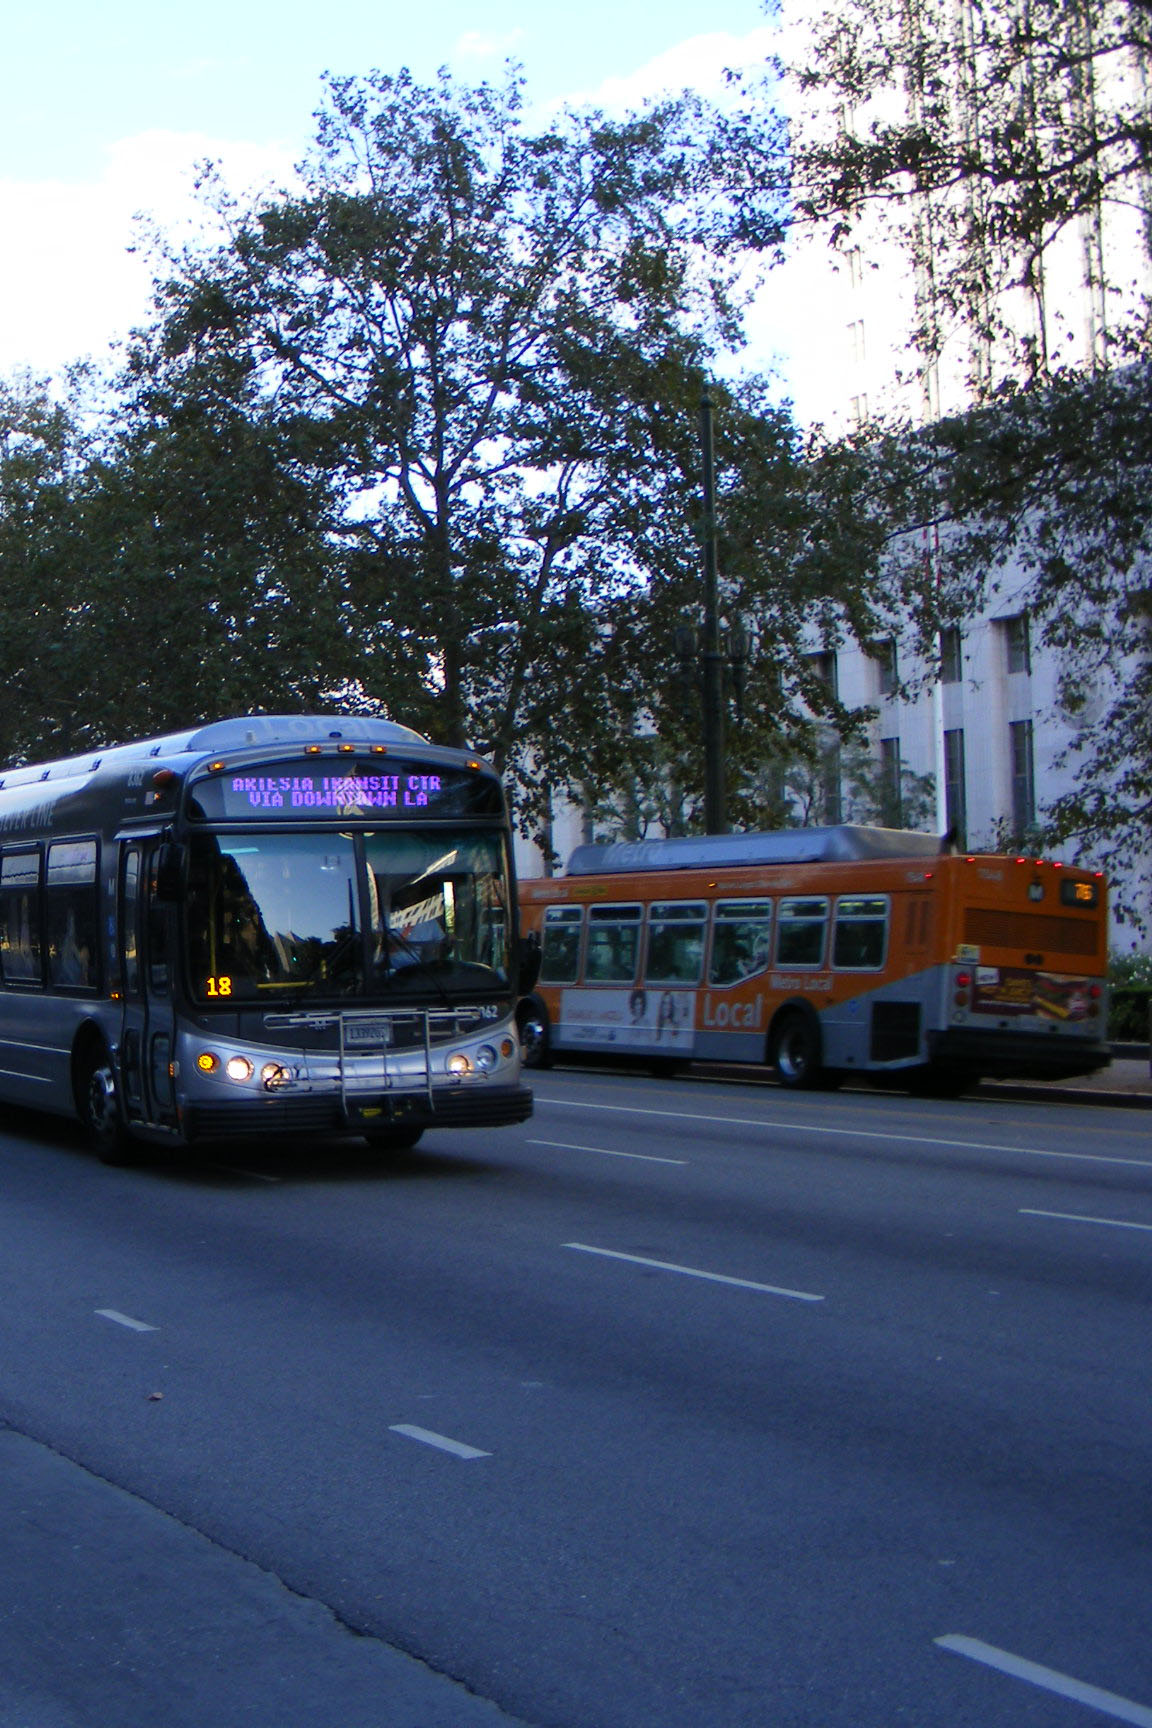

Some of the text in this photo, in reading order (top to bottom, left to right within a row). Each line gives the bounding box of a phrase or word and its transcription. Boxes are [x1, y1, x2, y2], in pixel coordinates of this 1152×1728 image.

[408, 775, 441, 790] CTR
[250, 791, 283, 806] VIA
[404, 791, 428, 805] LA
[207, 976, 232, 996] 18
[703, 993, 763, 1027] Local
